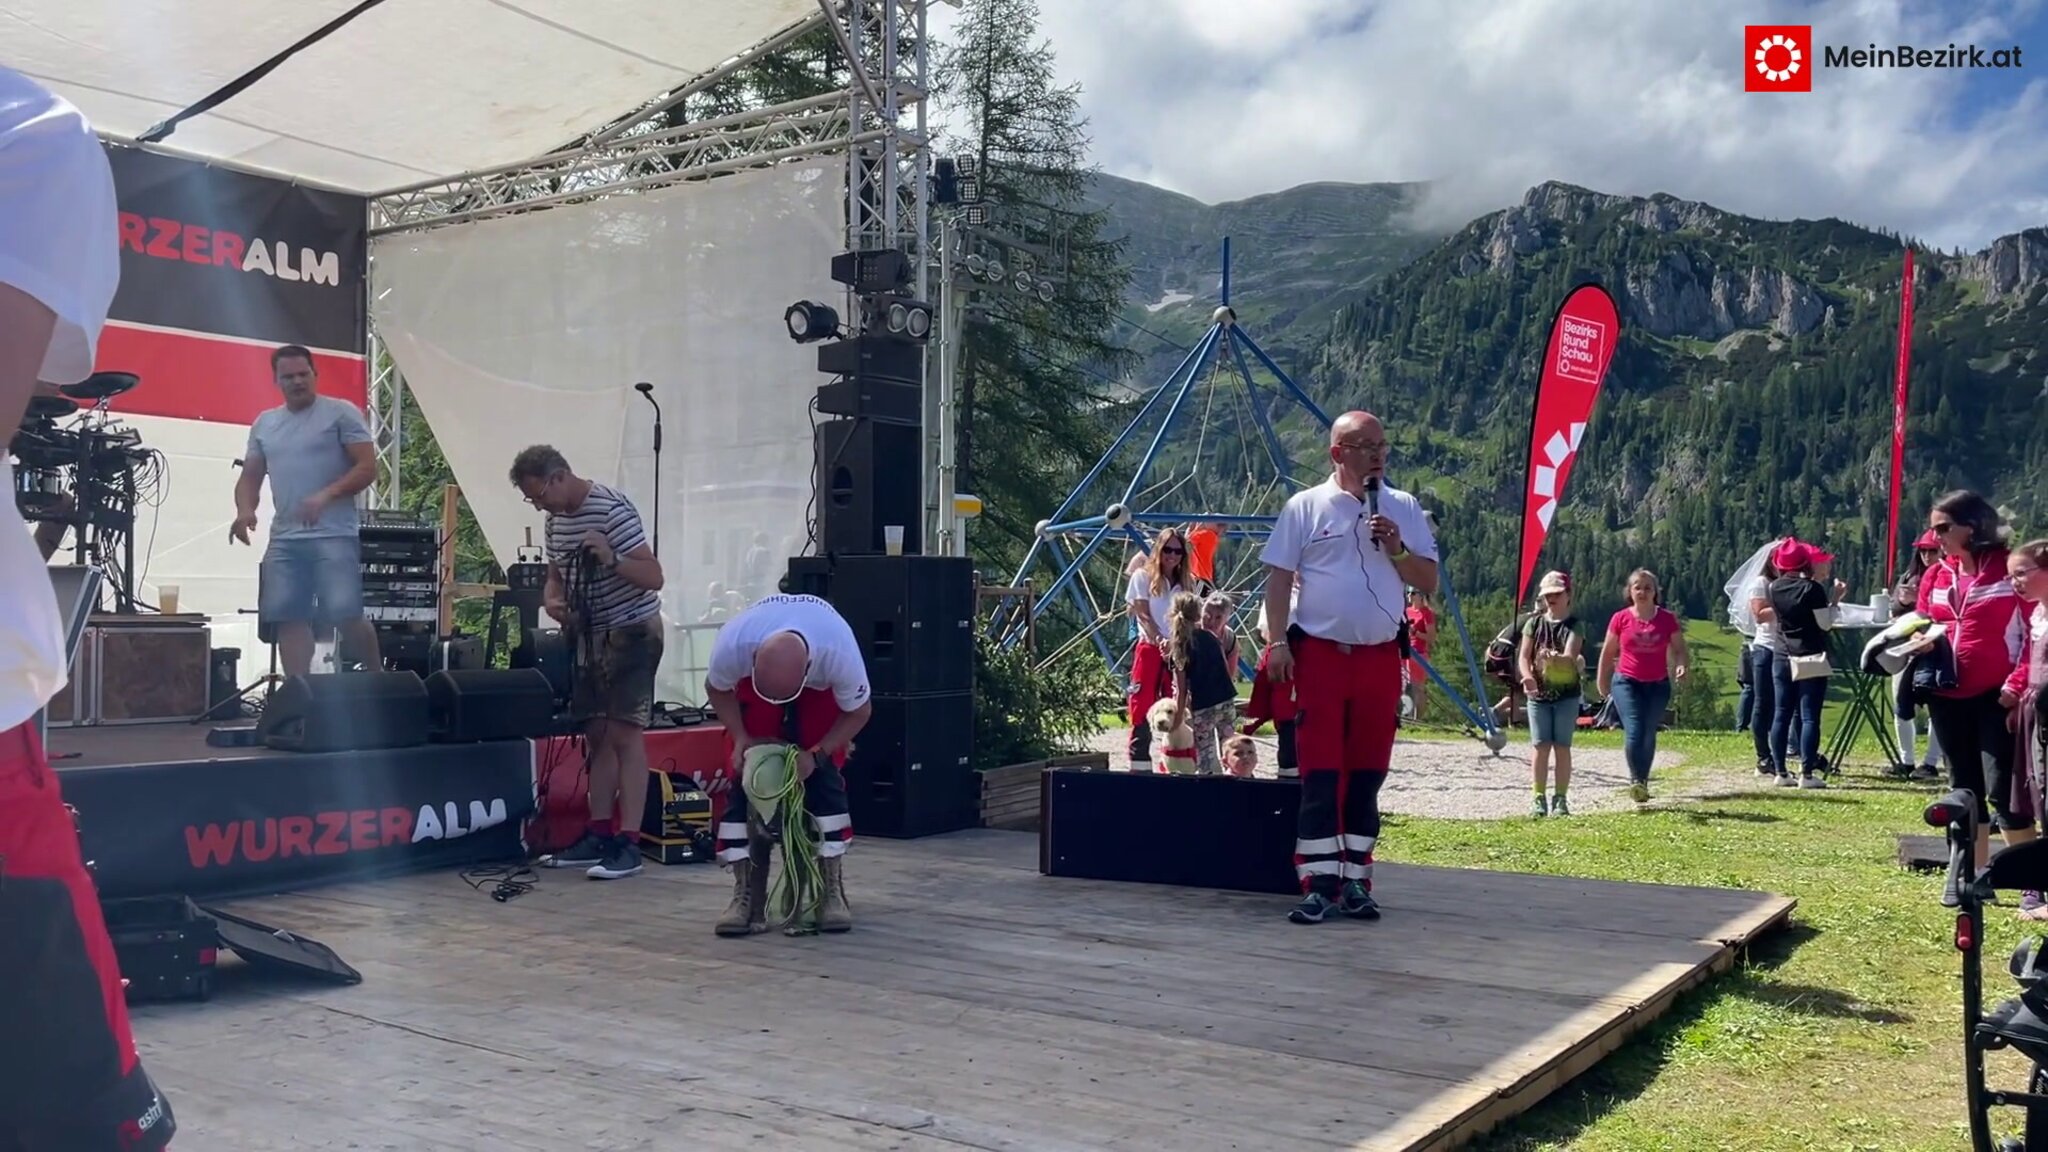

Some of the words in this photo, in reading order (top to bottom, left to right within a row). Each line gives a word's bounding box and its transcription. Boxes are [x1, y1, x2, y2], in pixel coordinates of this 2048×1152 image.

[118, 211, 339, 287] RZERALM
[1564, 320, 1598, 339] Bezirks
[1563, 332, 1589, 350] Rund
[1562, 345, 1593, 364] Schau
[184, 798, 507, 869] WURZERALM
